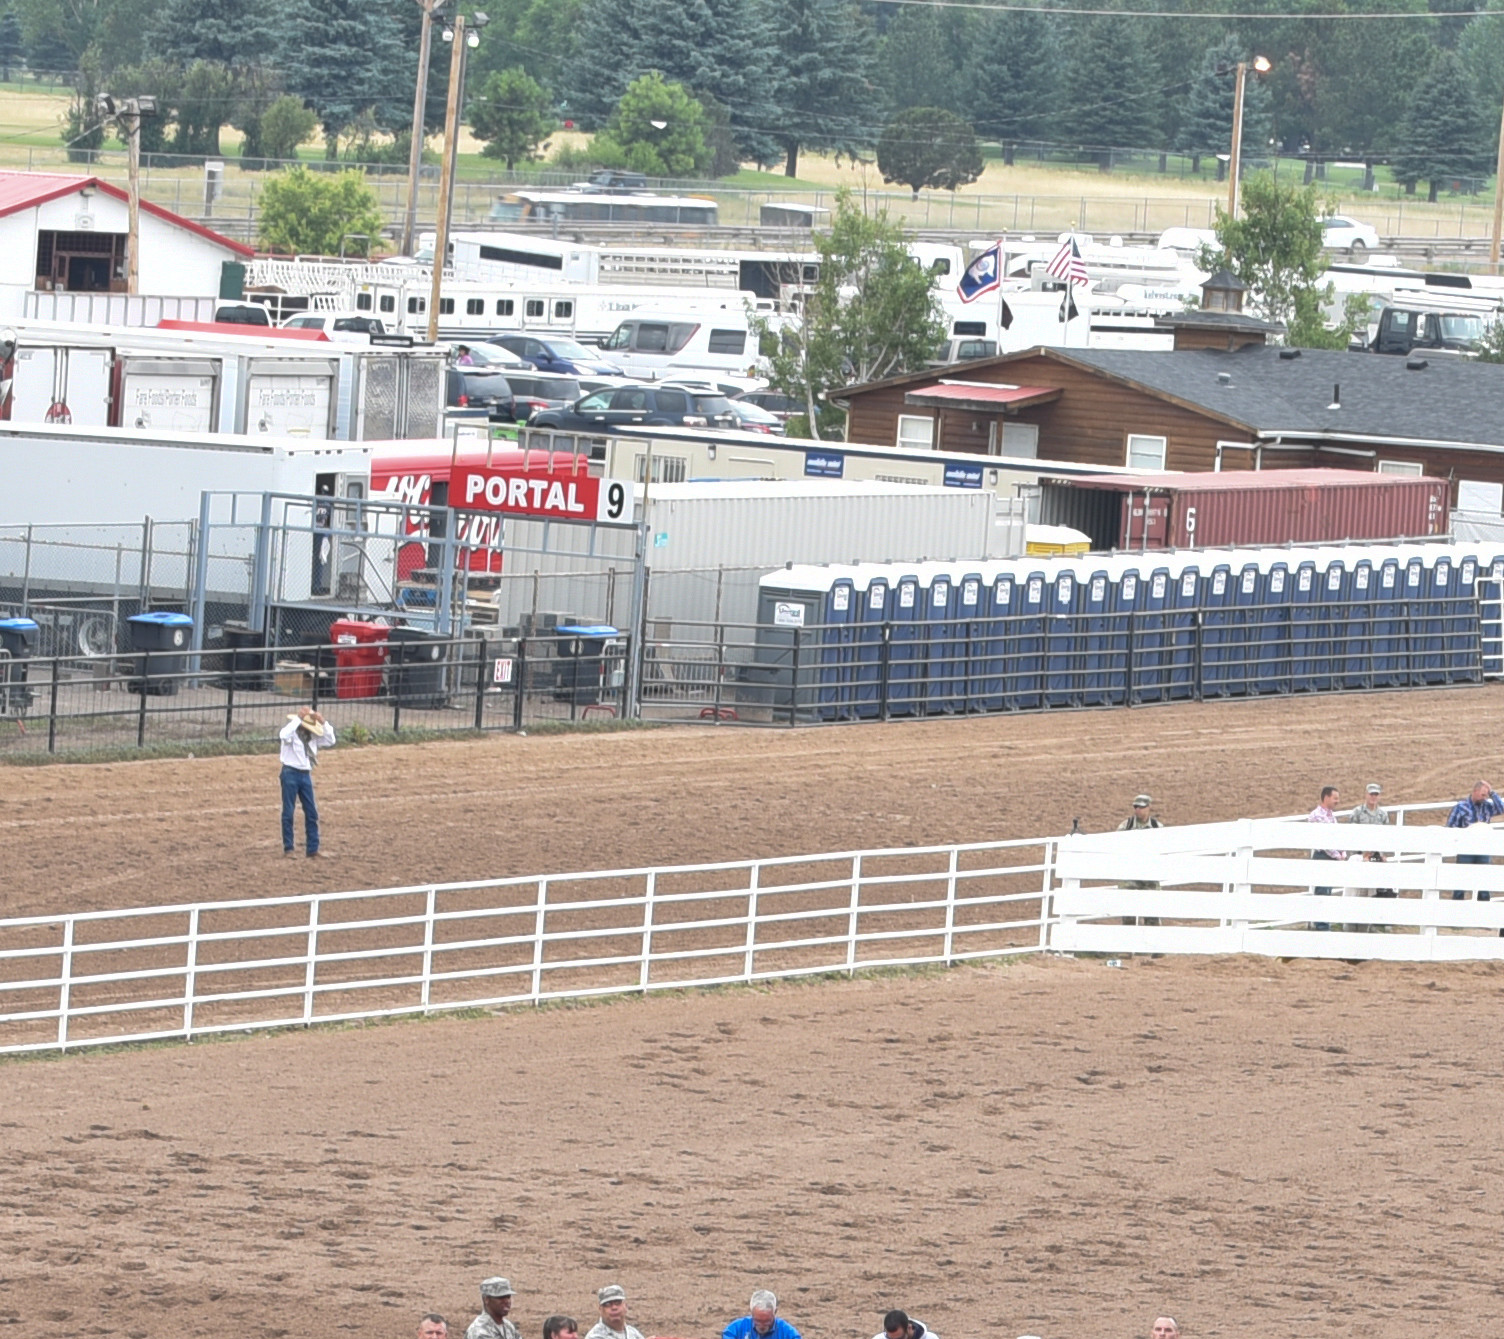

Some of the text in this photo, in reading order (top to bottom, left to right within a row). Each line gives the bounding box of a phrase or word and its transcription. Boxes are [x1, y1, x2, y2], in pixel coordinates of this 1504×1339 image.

[465, 474, 625, 519] PORTAL 9
[495, 661, 511, 681] EXIT
